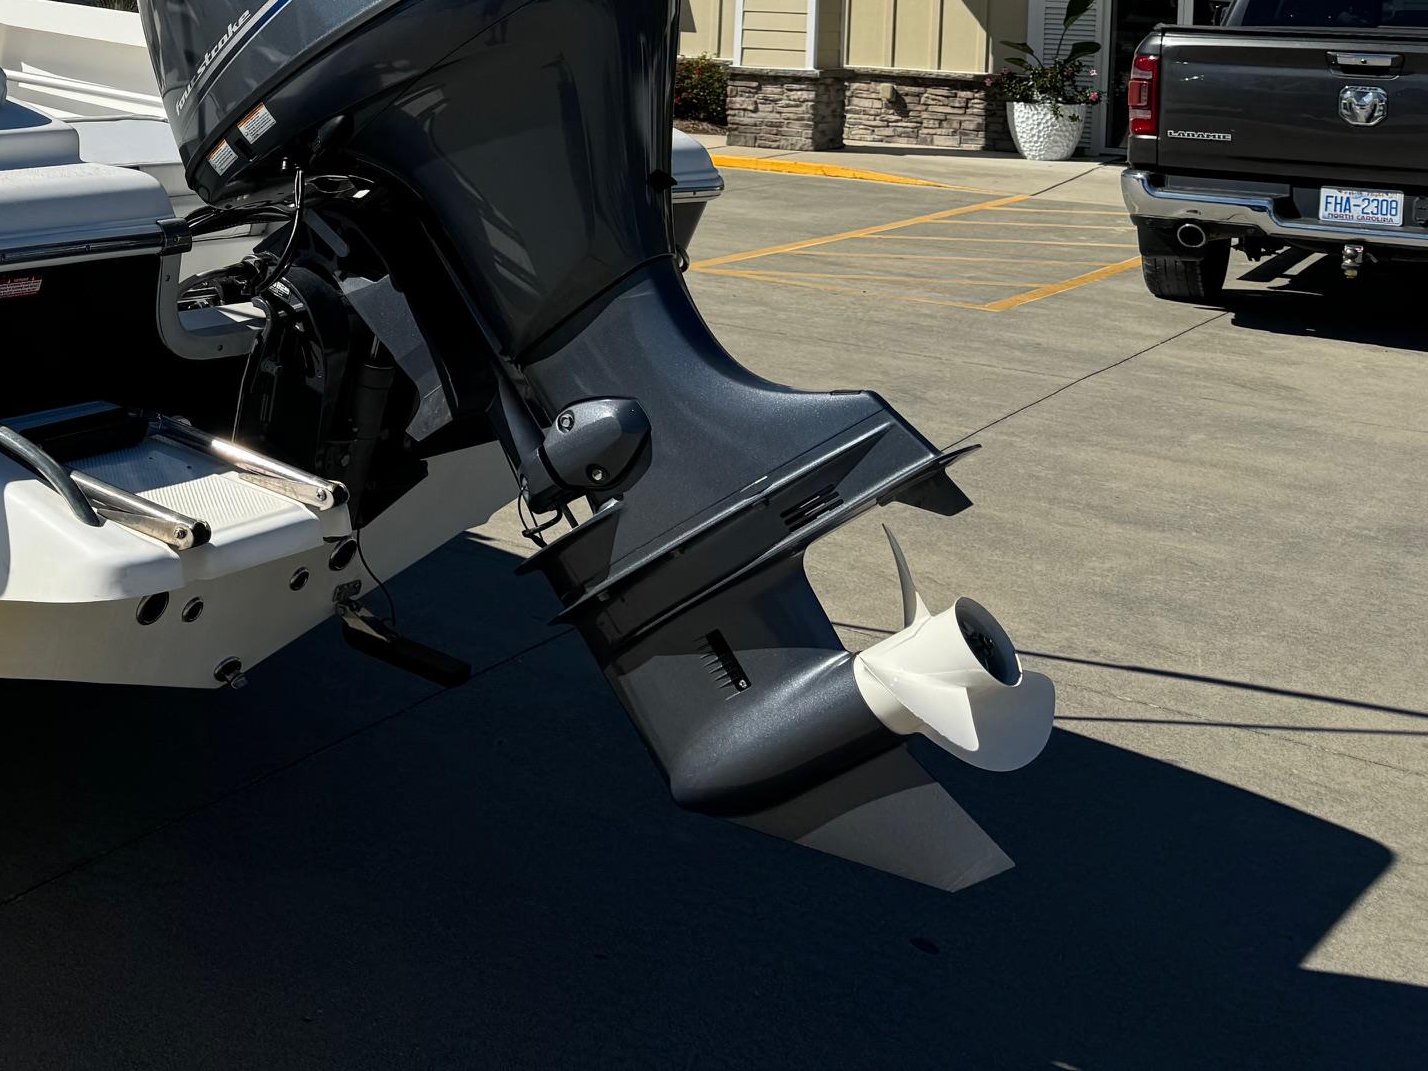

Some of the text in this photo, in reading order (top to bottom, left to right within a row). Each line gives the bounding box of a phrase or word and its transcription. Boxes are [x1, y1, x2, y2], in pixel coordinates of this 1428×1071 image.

[1167, 130, 1232, 141] LARAMIE
[1324, 195, 1399, 217] FHA-2308
[1327, 212, 1394, 223] NORTH CAROLINA
